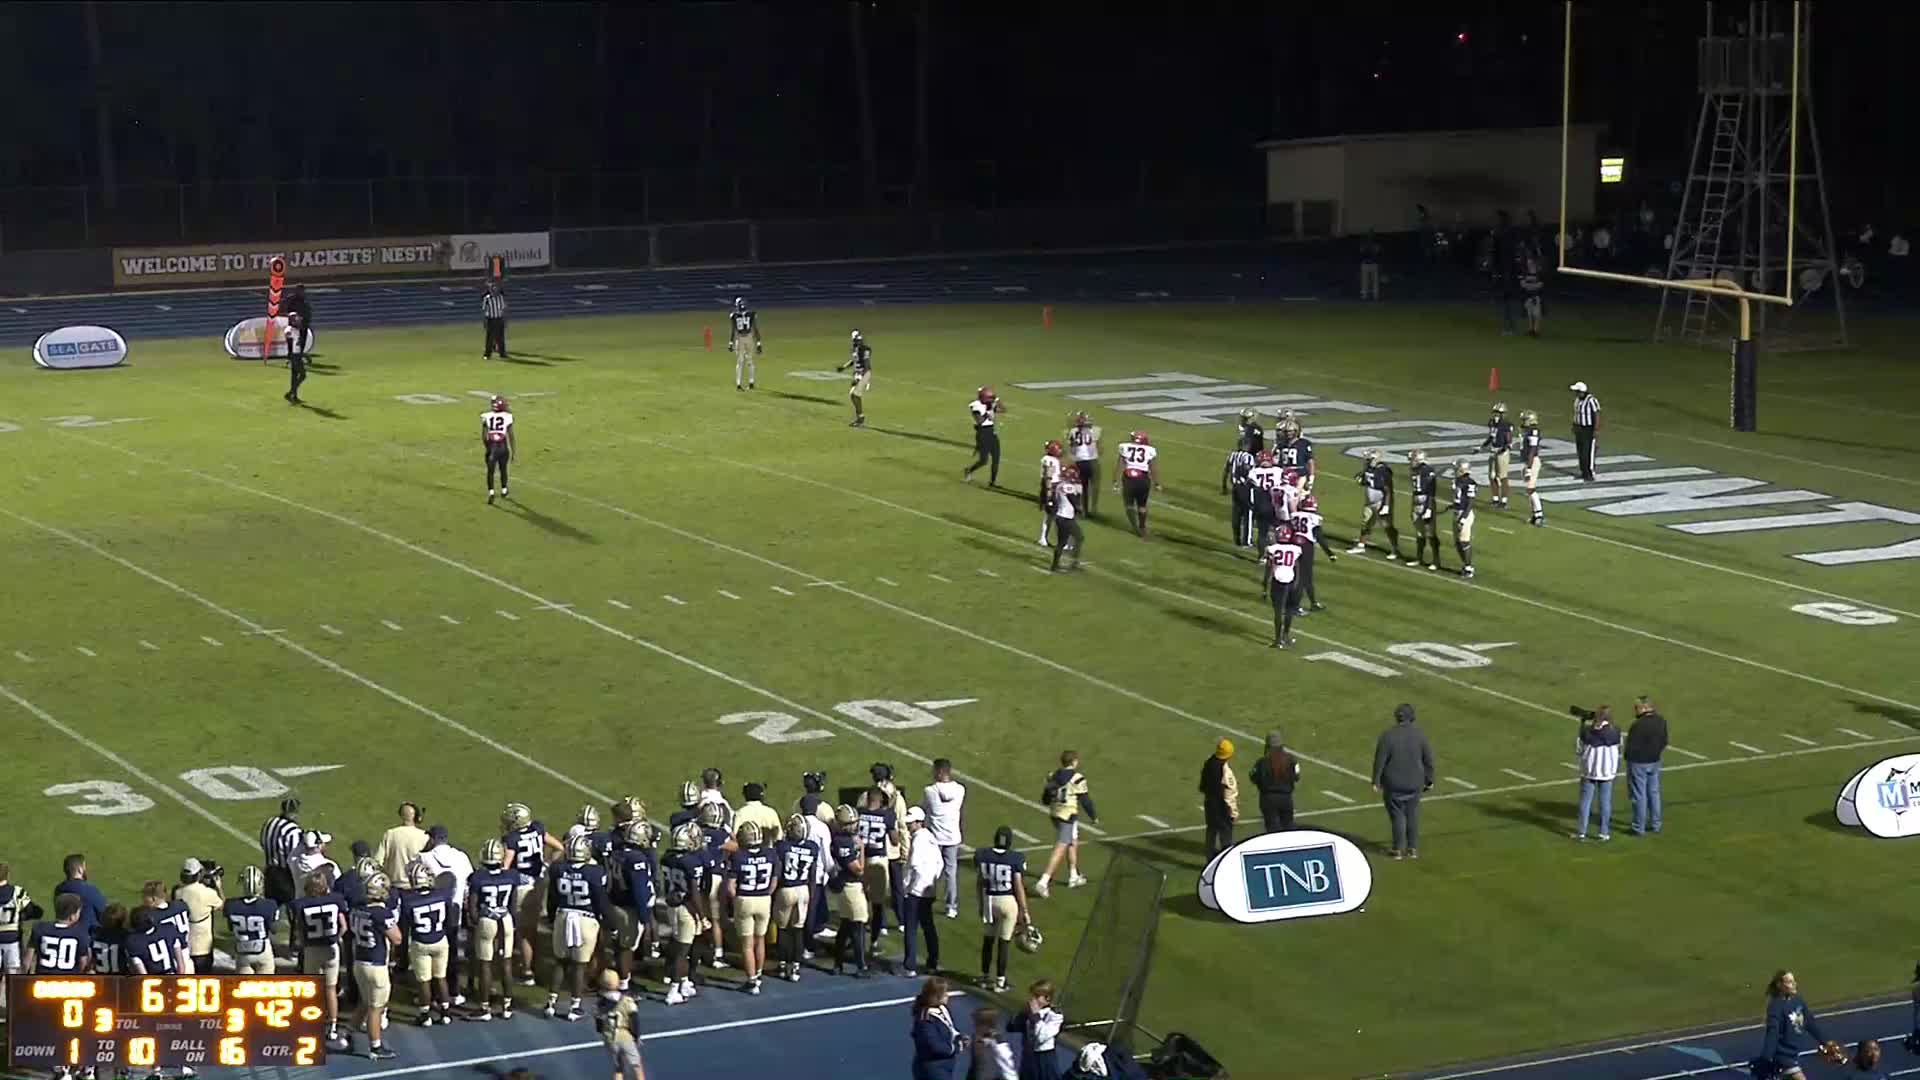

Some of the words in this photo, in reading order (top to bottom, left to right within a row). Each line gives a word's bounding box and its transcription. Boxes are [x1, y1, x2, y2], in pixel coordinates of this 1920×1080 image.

[122, 256, 217, 275] WELCOME
[222, 255, 245, 270] TO
[250, 253, 285, 269] TH
[290, 249, 377, 267] JACKETS'
[381, 246, 433, 263] NEST!
[49, 344, 75, 354] SEA
[80, 340, 117, 353] GATE
[490, 416, 504, 431] 12
[1127, 448, 1146, 463] 73
[1256, 474, 1275, 491] 75
[1275, 551, 1294, 567] 20
[517, 835, 544, 868] 24
[740, 863, 772, 891] 33
[981, 862, 1012, 892] 48
[1253, 860, 1330, 898] TNB
[481, 884, 513, 909] 37
[558, 878, 591, 906] 92
[230, 914, 267, 941] 29
[303, 904, 339, 940] 53
[412, 901, 447, 934] 57
[40, 936, 79, 970] 50
[93, 942, 120, 974] 31
[148, 939, 171, 970] 4
